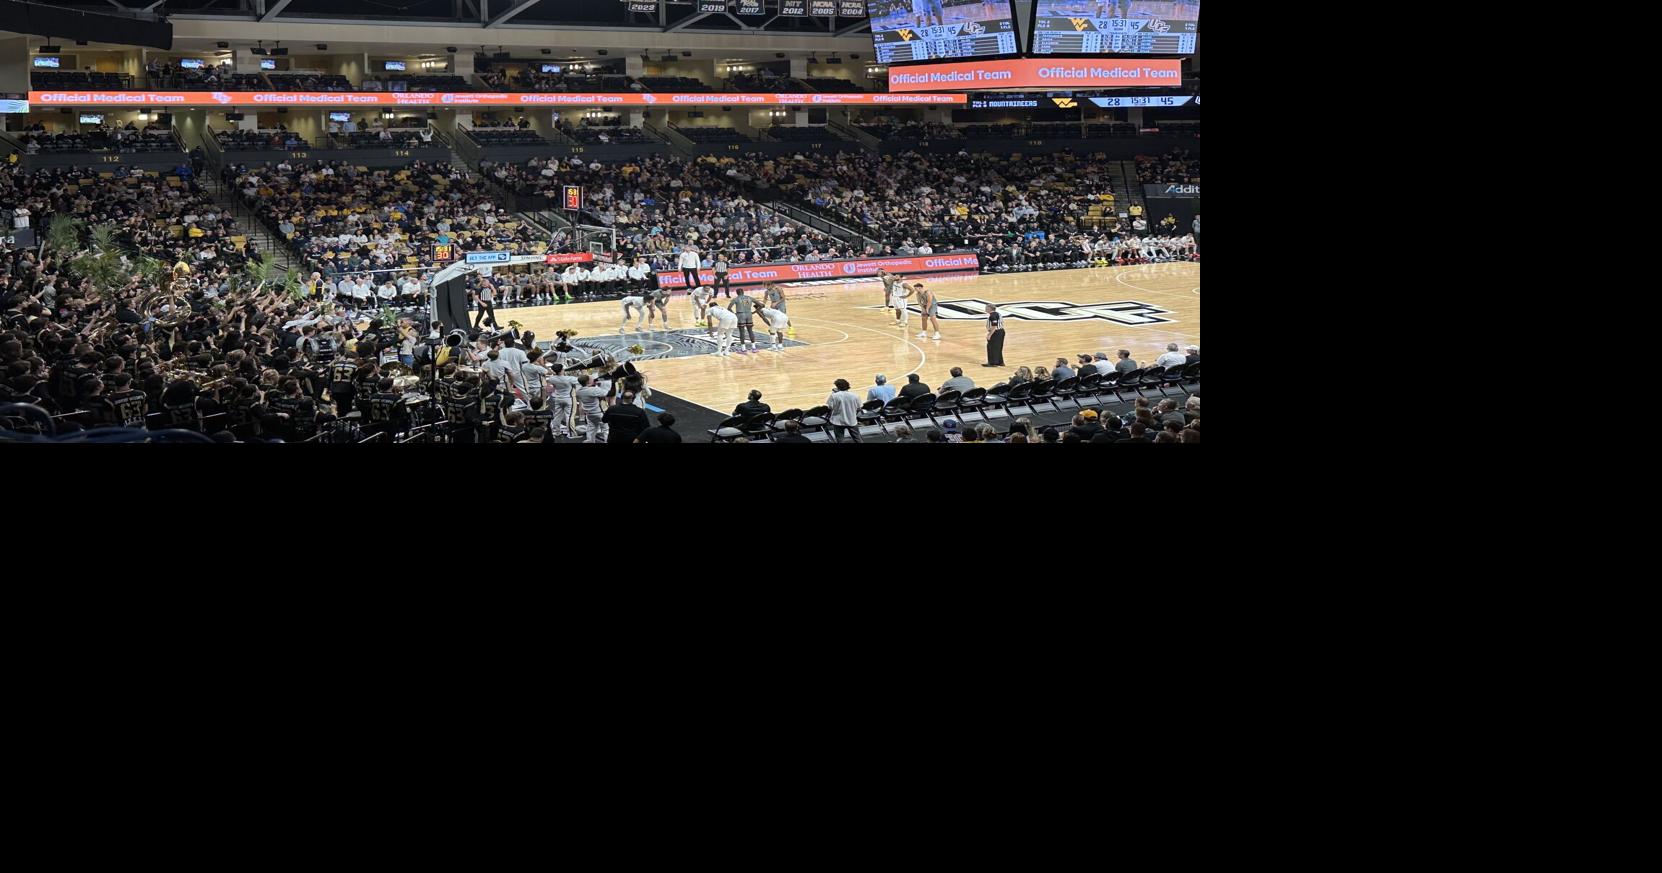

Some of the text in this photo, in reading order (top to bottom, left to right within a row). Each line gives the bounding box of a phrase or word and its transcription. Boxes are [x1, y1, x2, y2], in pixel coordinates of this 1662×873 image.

[1098, 21, 1108, 29] 28
[1130, 21, 1140, 30] 45
[920, 26, 957, 38] 28 15:31 45
[890, 70, 1012, 84] Official Medical Team
[1038, 67, 1178, 78] Official Medical Team
[40, 93, 185, 102] Official Medical Team
[253, 94, 378, 102] Official Medical Team
[1107, 98, 1120, 106] 28
[1160, 97, 1174, 105] 45
[437, 251, 449, 260] 30
[926, 258, 961, 267] Official
[791, 263, 835, 272] ORLANDO
[744, 270, 778, 280] Team
[798, 270, 832, 279] HEALTH
[334, 367, 354, 381] 63
